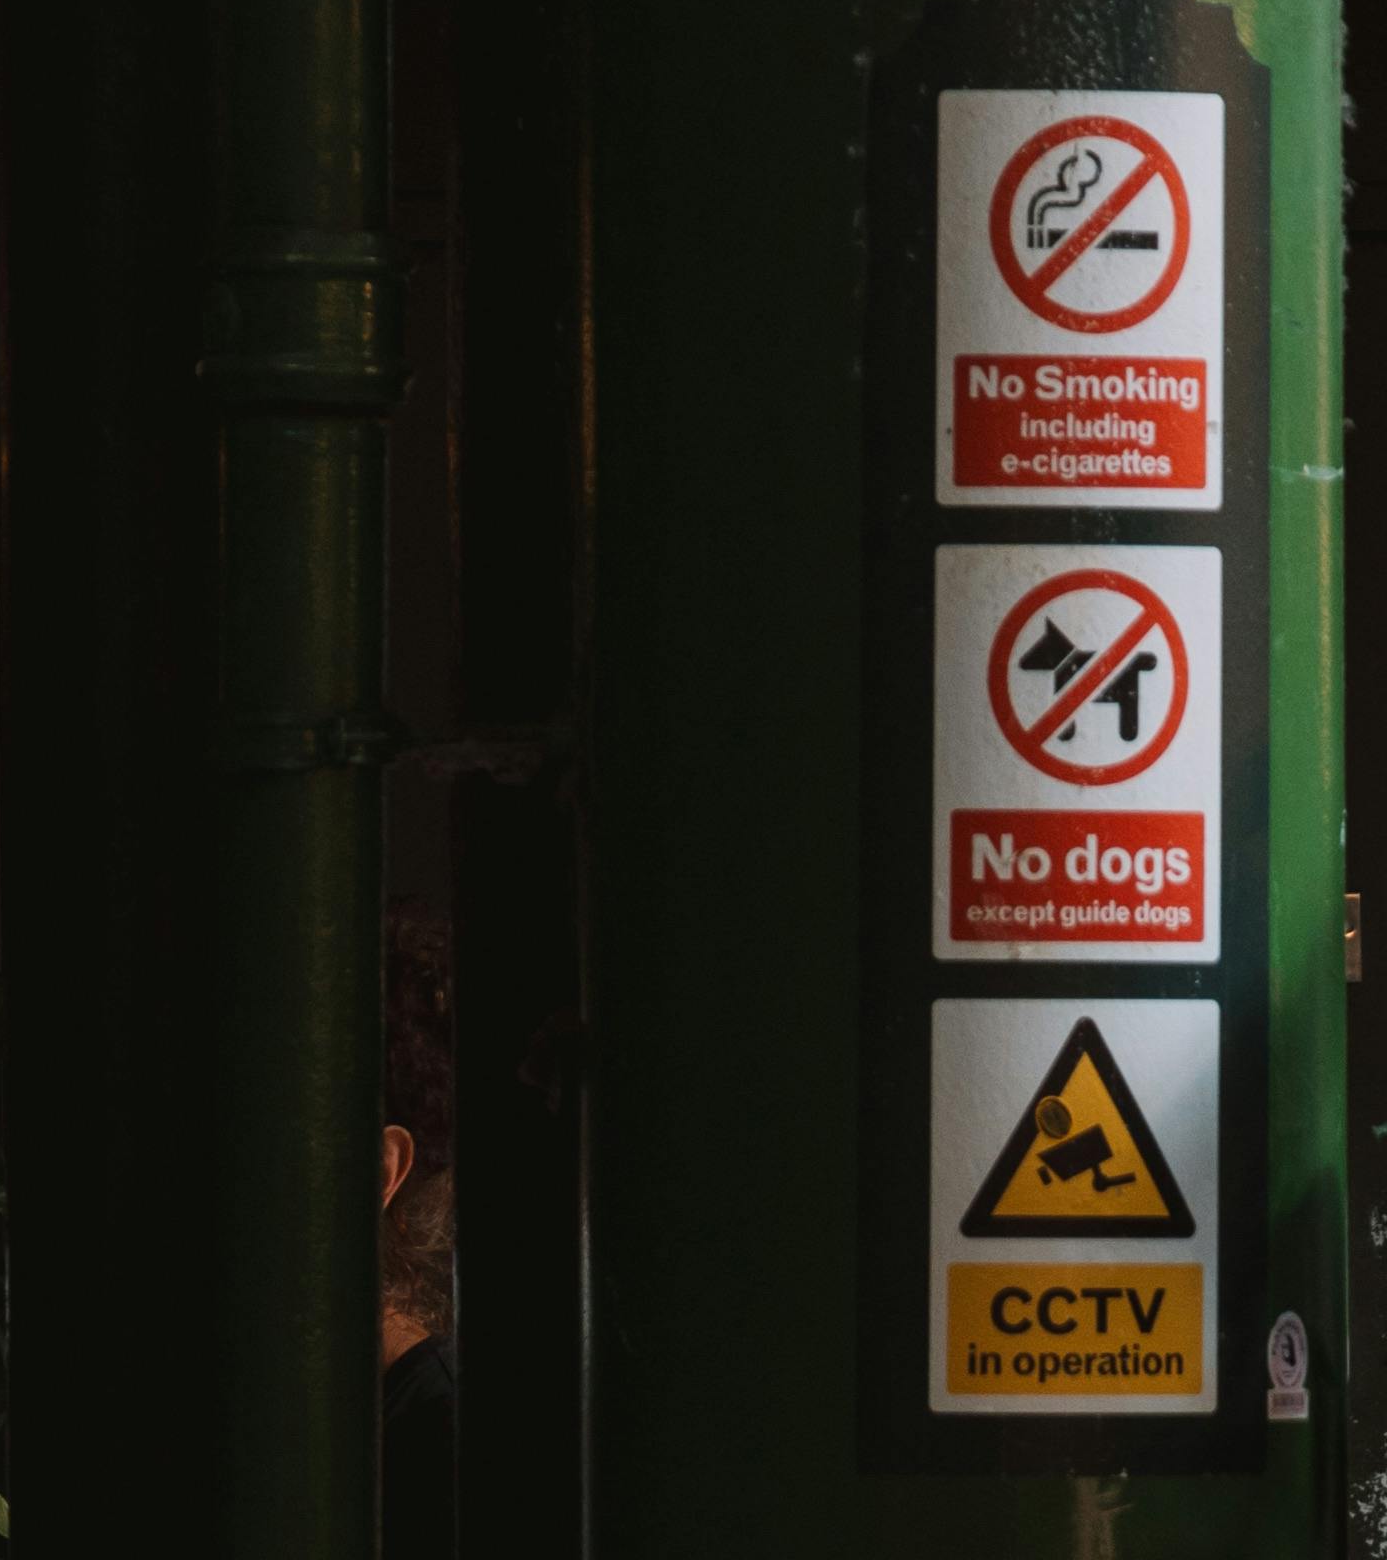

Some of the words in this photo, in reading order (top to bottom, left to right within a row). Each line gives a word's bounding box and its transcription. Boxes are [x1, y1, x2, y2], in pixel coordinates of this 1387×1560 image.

[968, 364, 1024, 400] No
[1034, 364, 1200, 411] Smoking
[1019, 411, 1156, 447] including
[1000, 446, 1172, 479] e-cigarettes
[971, 832, 1052, 882] No
[1064, 833, 1191, 894] dogs
[966, 900, 1055, 928] except
[1059, 900, 1130, 928] guide
[1134, 900, 1192, 931] dogs
[989, 1286, 1166, 1335] CCTV
[967, 1342, 1003, 1376] in
[1012, 1342, 1184, 1384] operation
